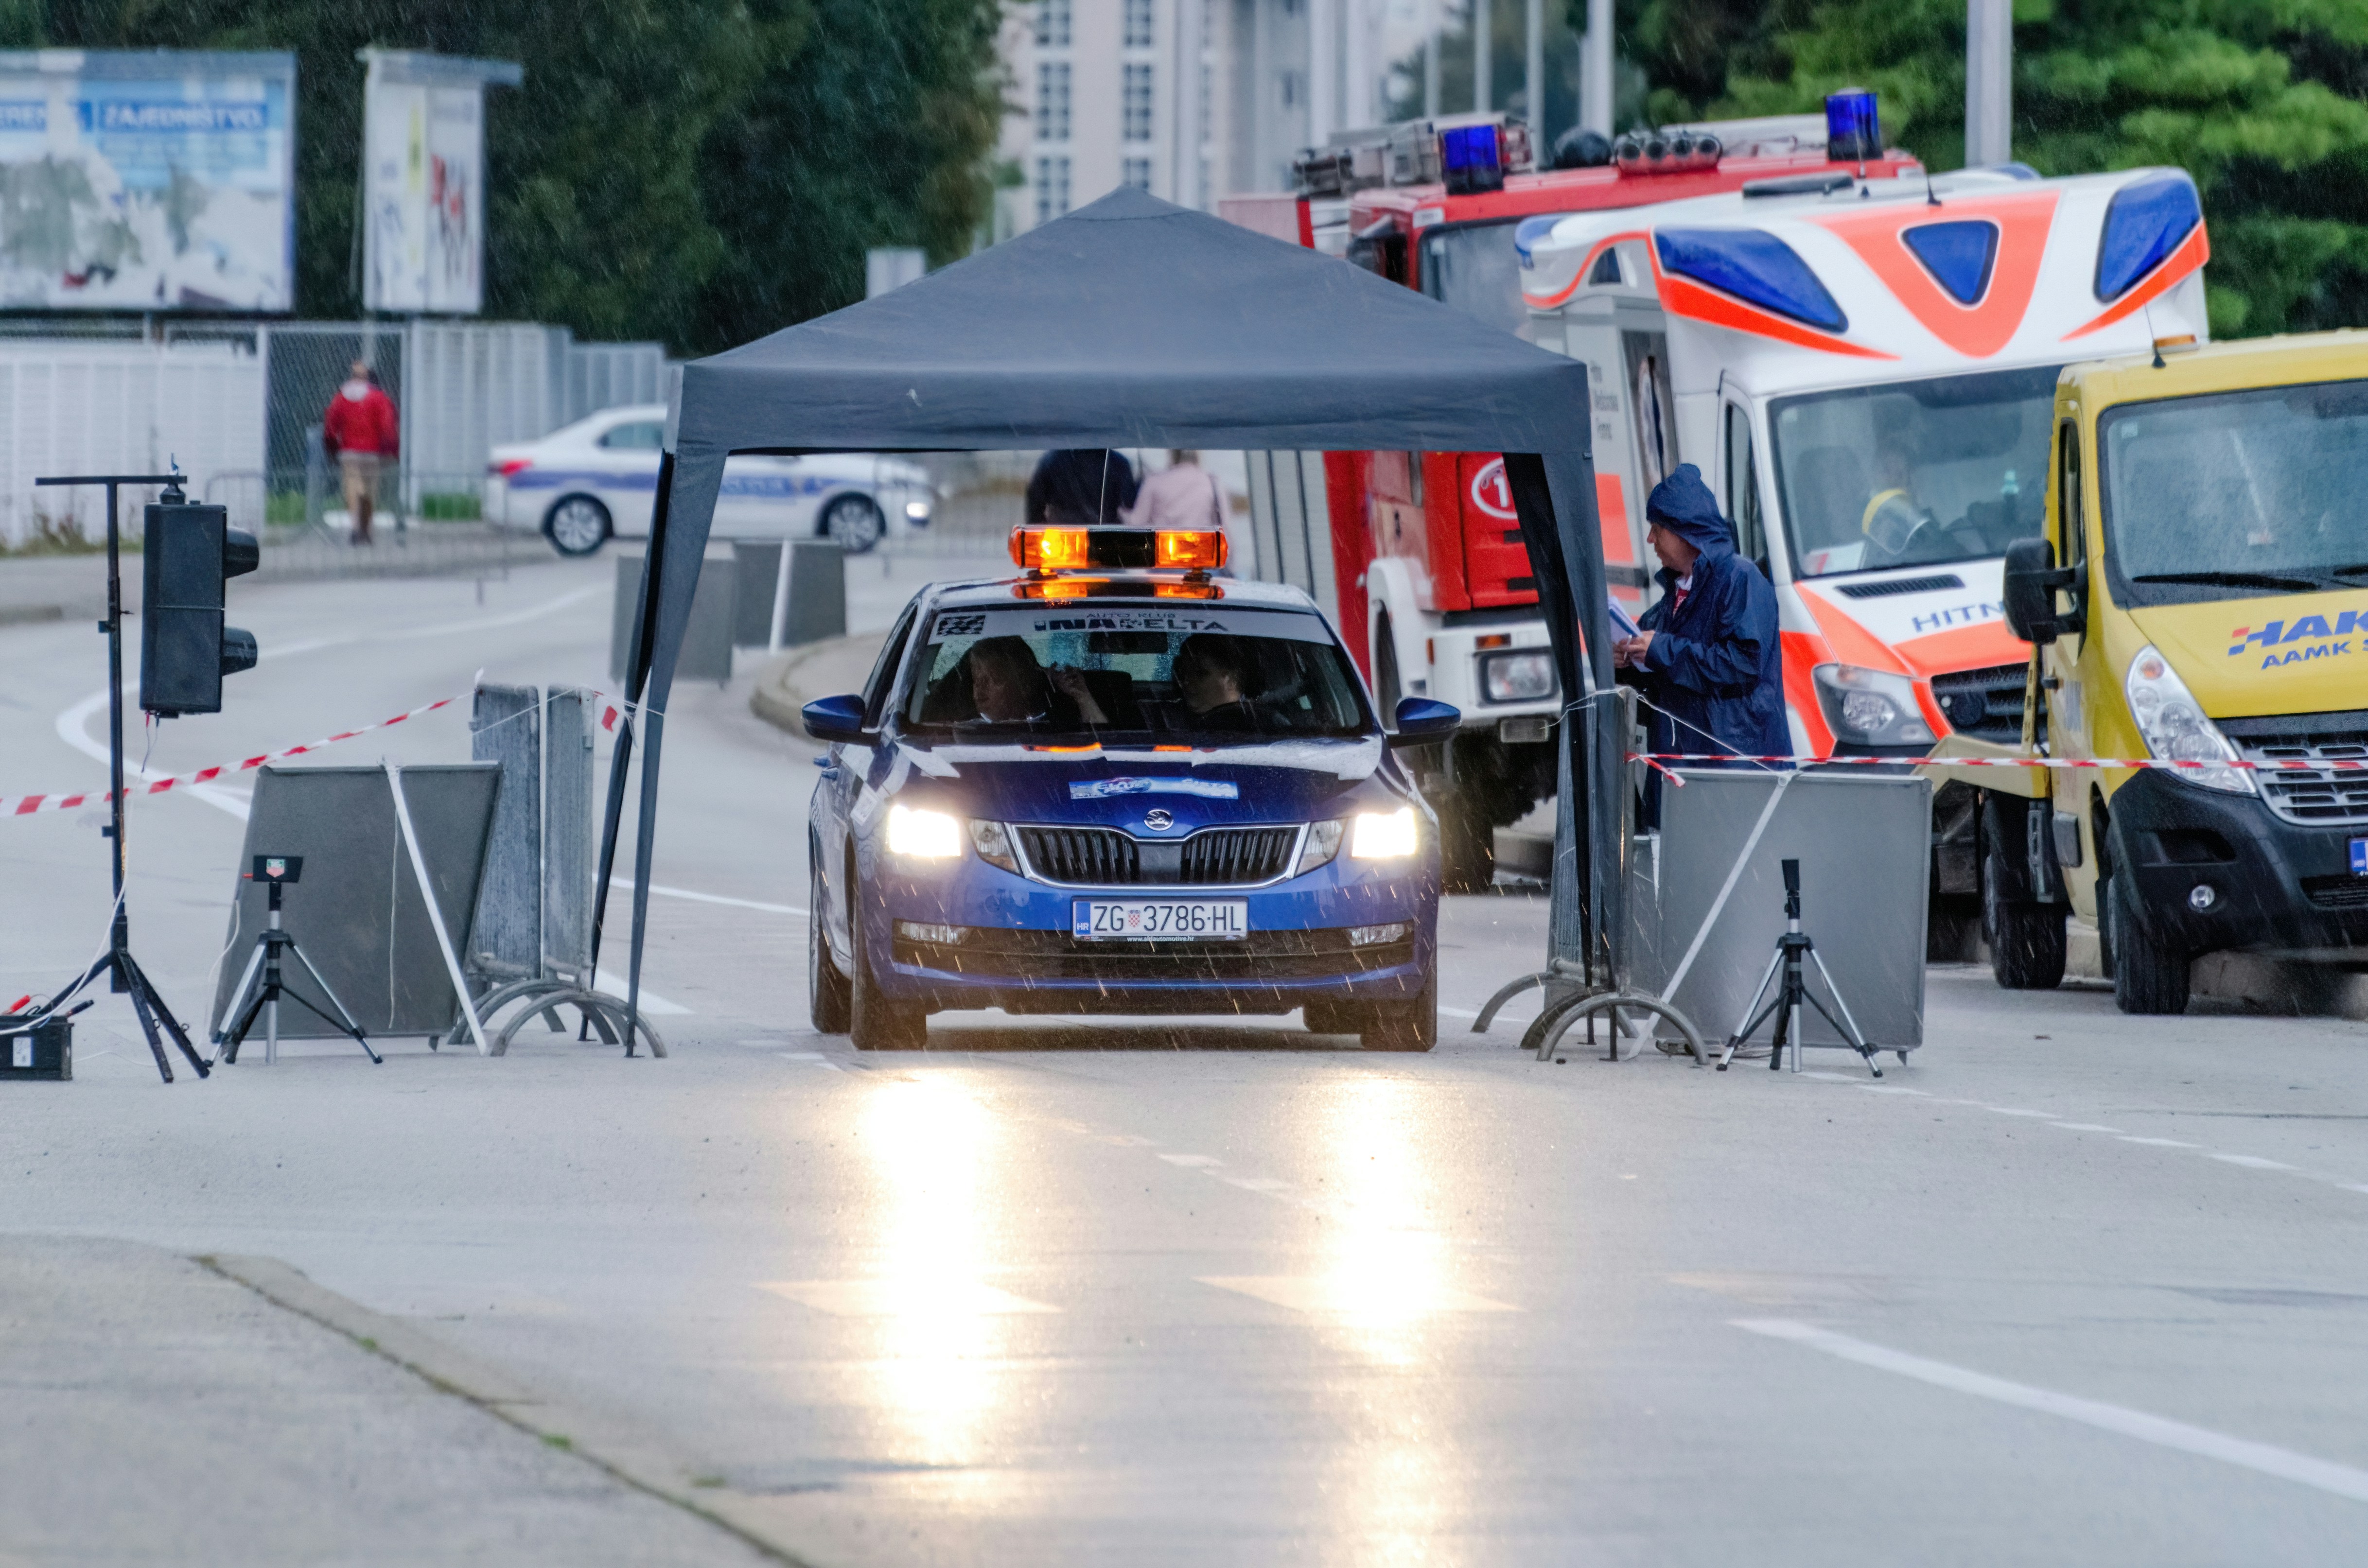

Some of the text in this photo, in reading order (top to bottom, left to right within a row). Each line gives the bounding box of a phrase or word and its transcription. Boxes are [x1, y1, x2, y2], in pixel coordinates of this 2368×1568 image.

[2261, 640, 2351, 671] AAMK
[1076, 922, 1089, 931] HR
[1094, 905, 1124, 932] ZG
